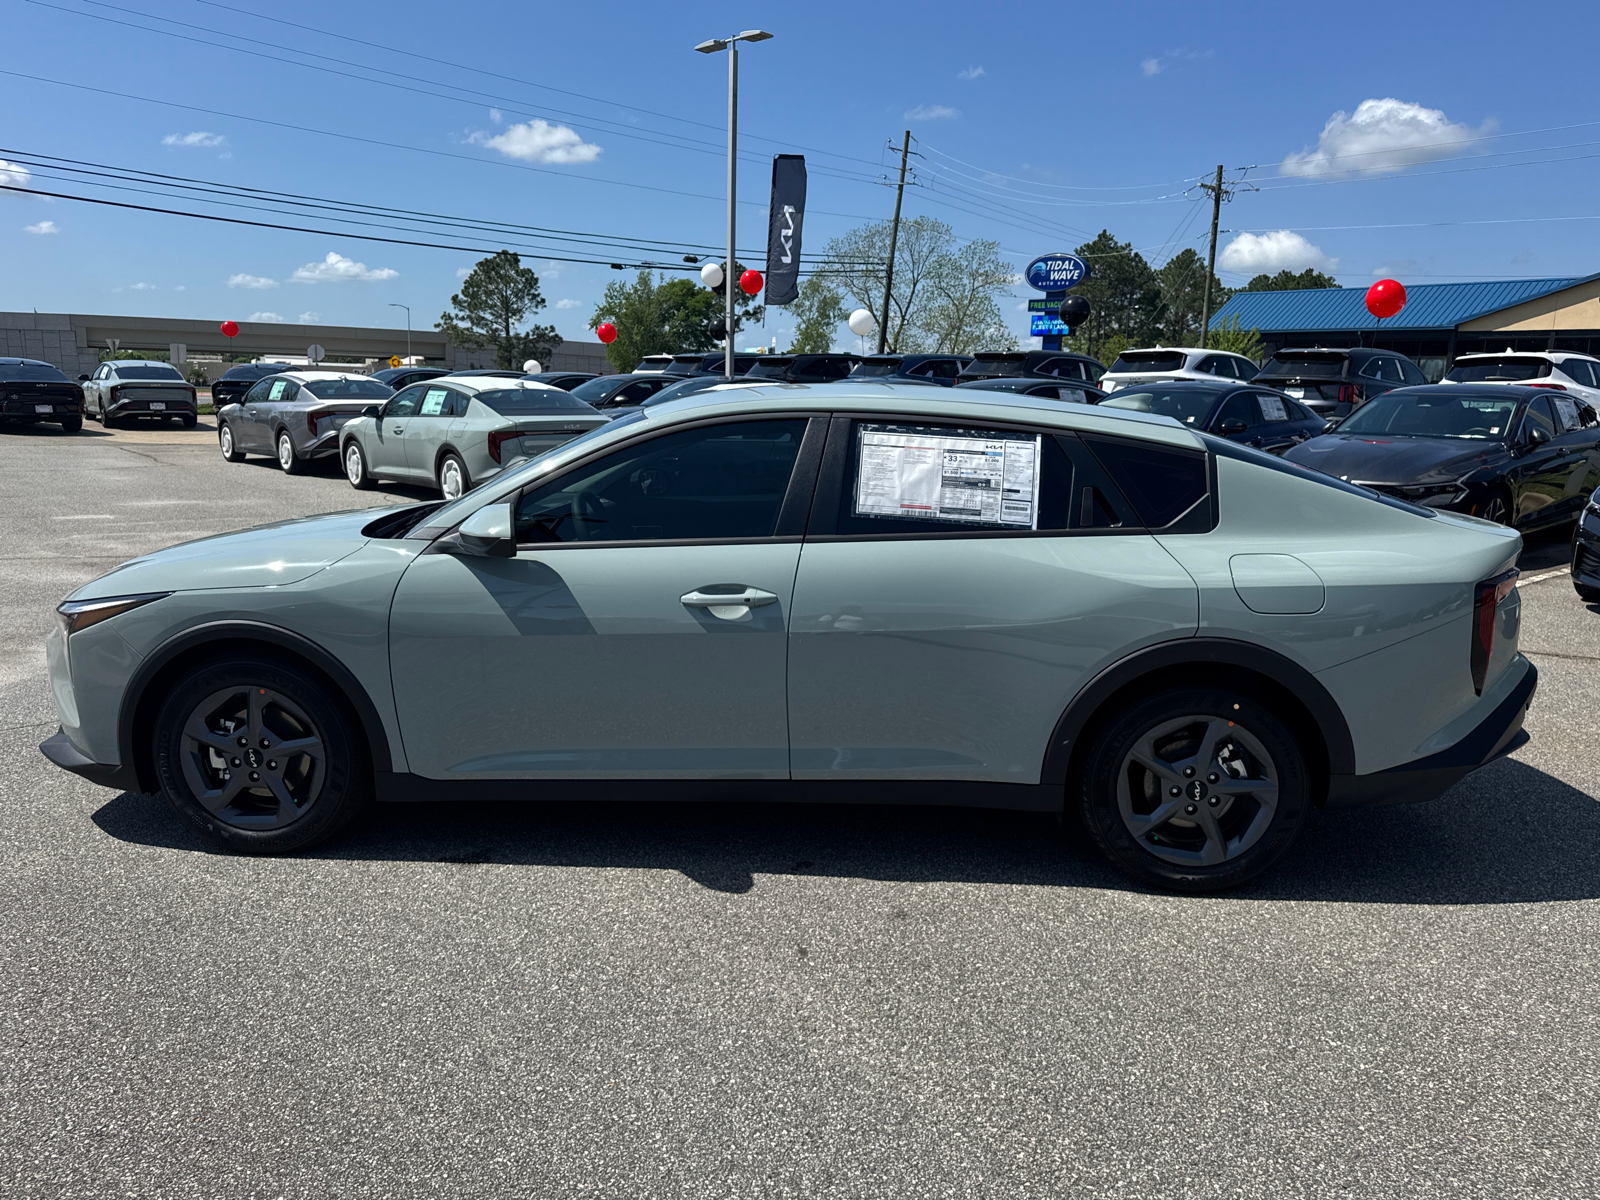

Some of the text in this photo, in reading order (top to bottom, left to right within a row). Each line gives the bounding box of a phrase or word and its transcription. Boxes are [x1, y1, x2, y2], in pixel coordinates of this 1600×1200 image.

[780, 205, 796, 264] KIA
[1046, 260, 1074, 270] TIDAL
[1050, 270, 1080, 280] WAVE
[248, 748, 258, 768] KIA
